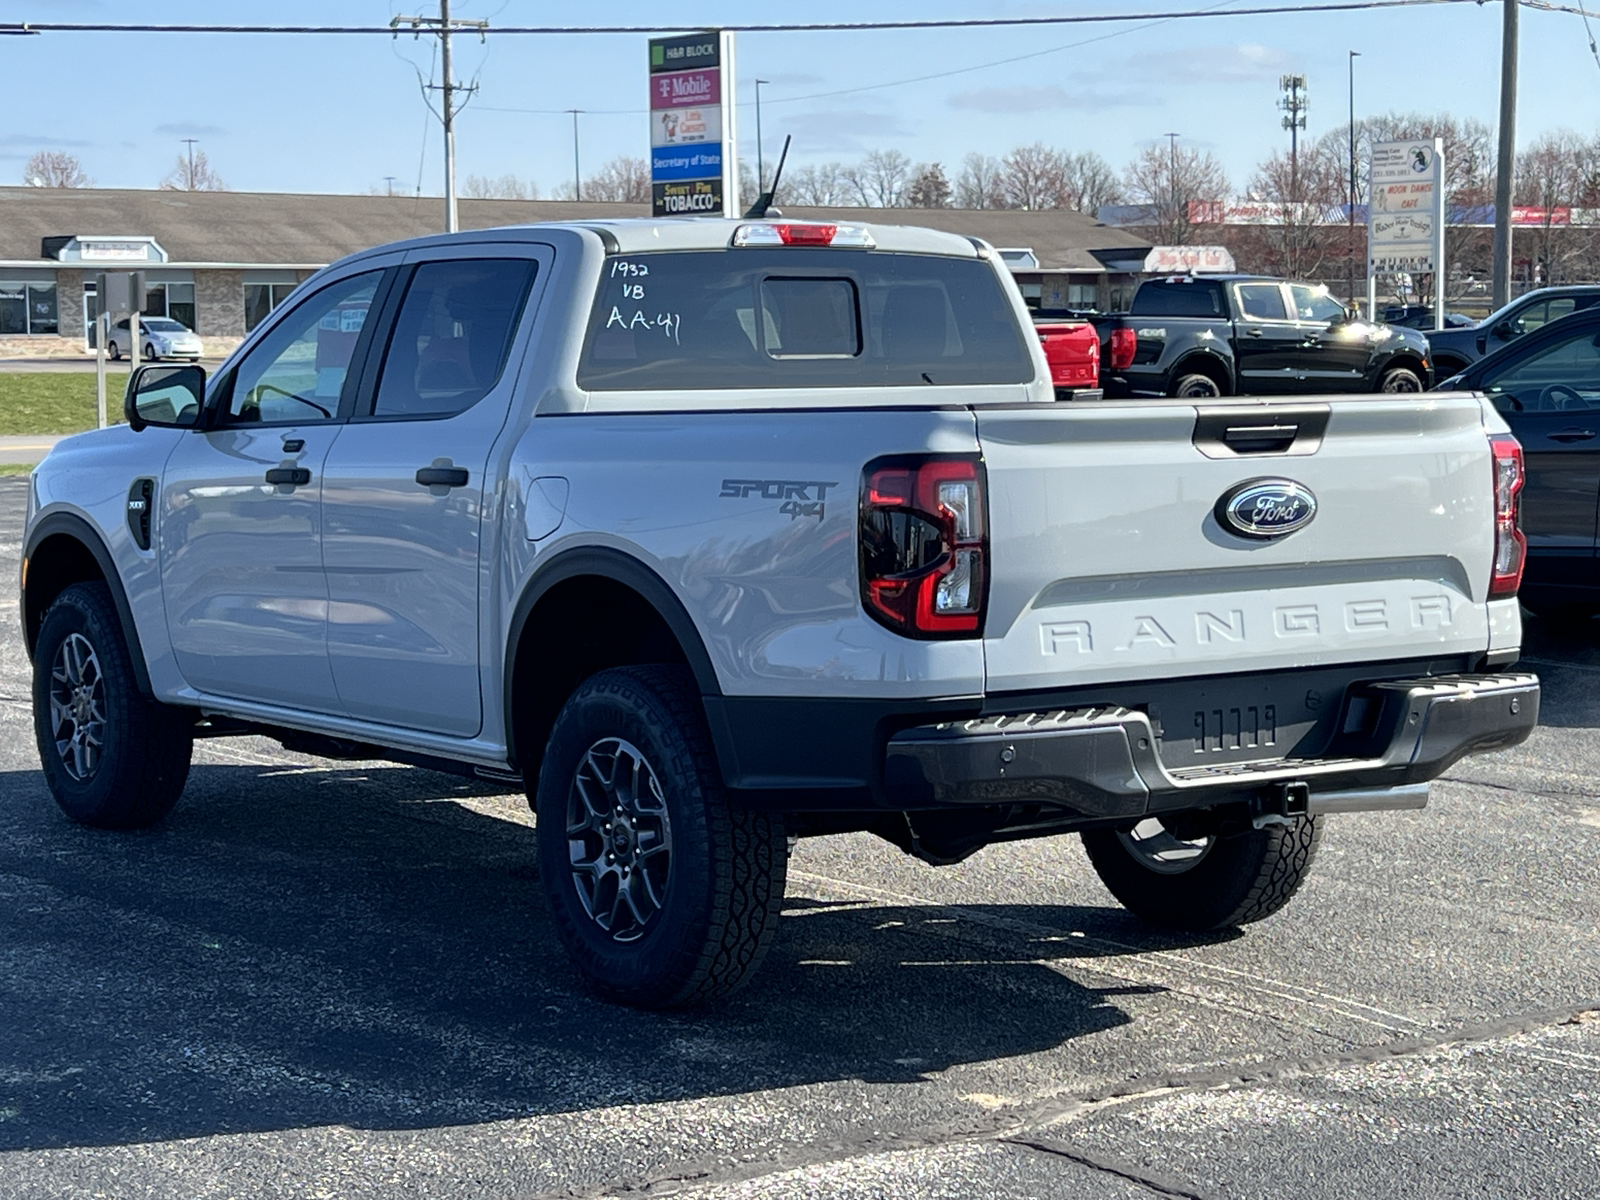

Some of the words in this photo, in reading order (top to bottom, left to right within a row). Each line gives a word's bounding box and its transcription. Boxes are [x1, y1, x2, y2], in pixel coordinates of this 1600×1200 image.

[666, 47, 684, 60] H&R
[686, 43, 714, 58] BLOCK
[672, 75, 711, 97] Mobile
[653, 157, 690, 169] Secretary
[690, 154, 699, 166] of
[700, 154, 720, 166] State
[1387, 185, 1408, 195] MOON
[1410, 183, 1434, 193] DANCE
[663, 193, 714, 212] TOBACCO
[610, 261, 650, 279] 1932
[718, 479, 840, 501] SPORT
[1252, 495, 1299, 524] Ford
[1038, 594, 1454, 657] RANGER
